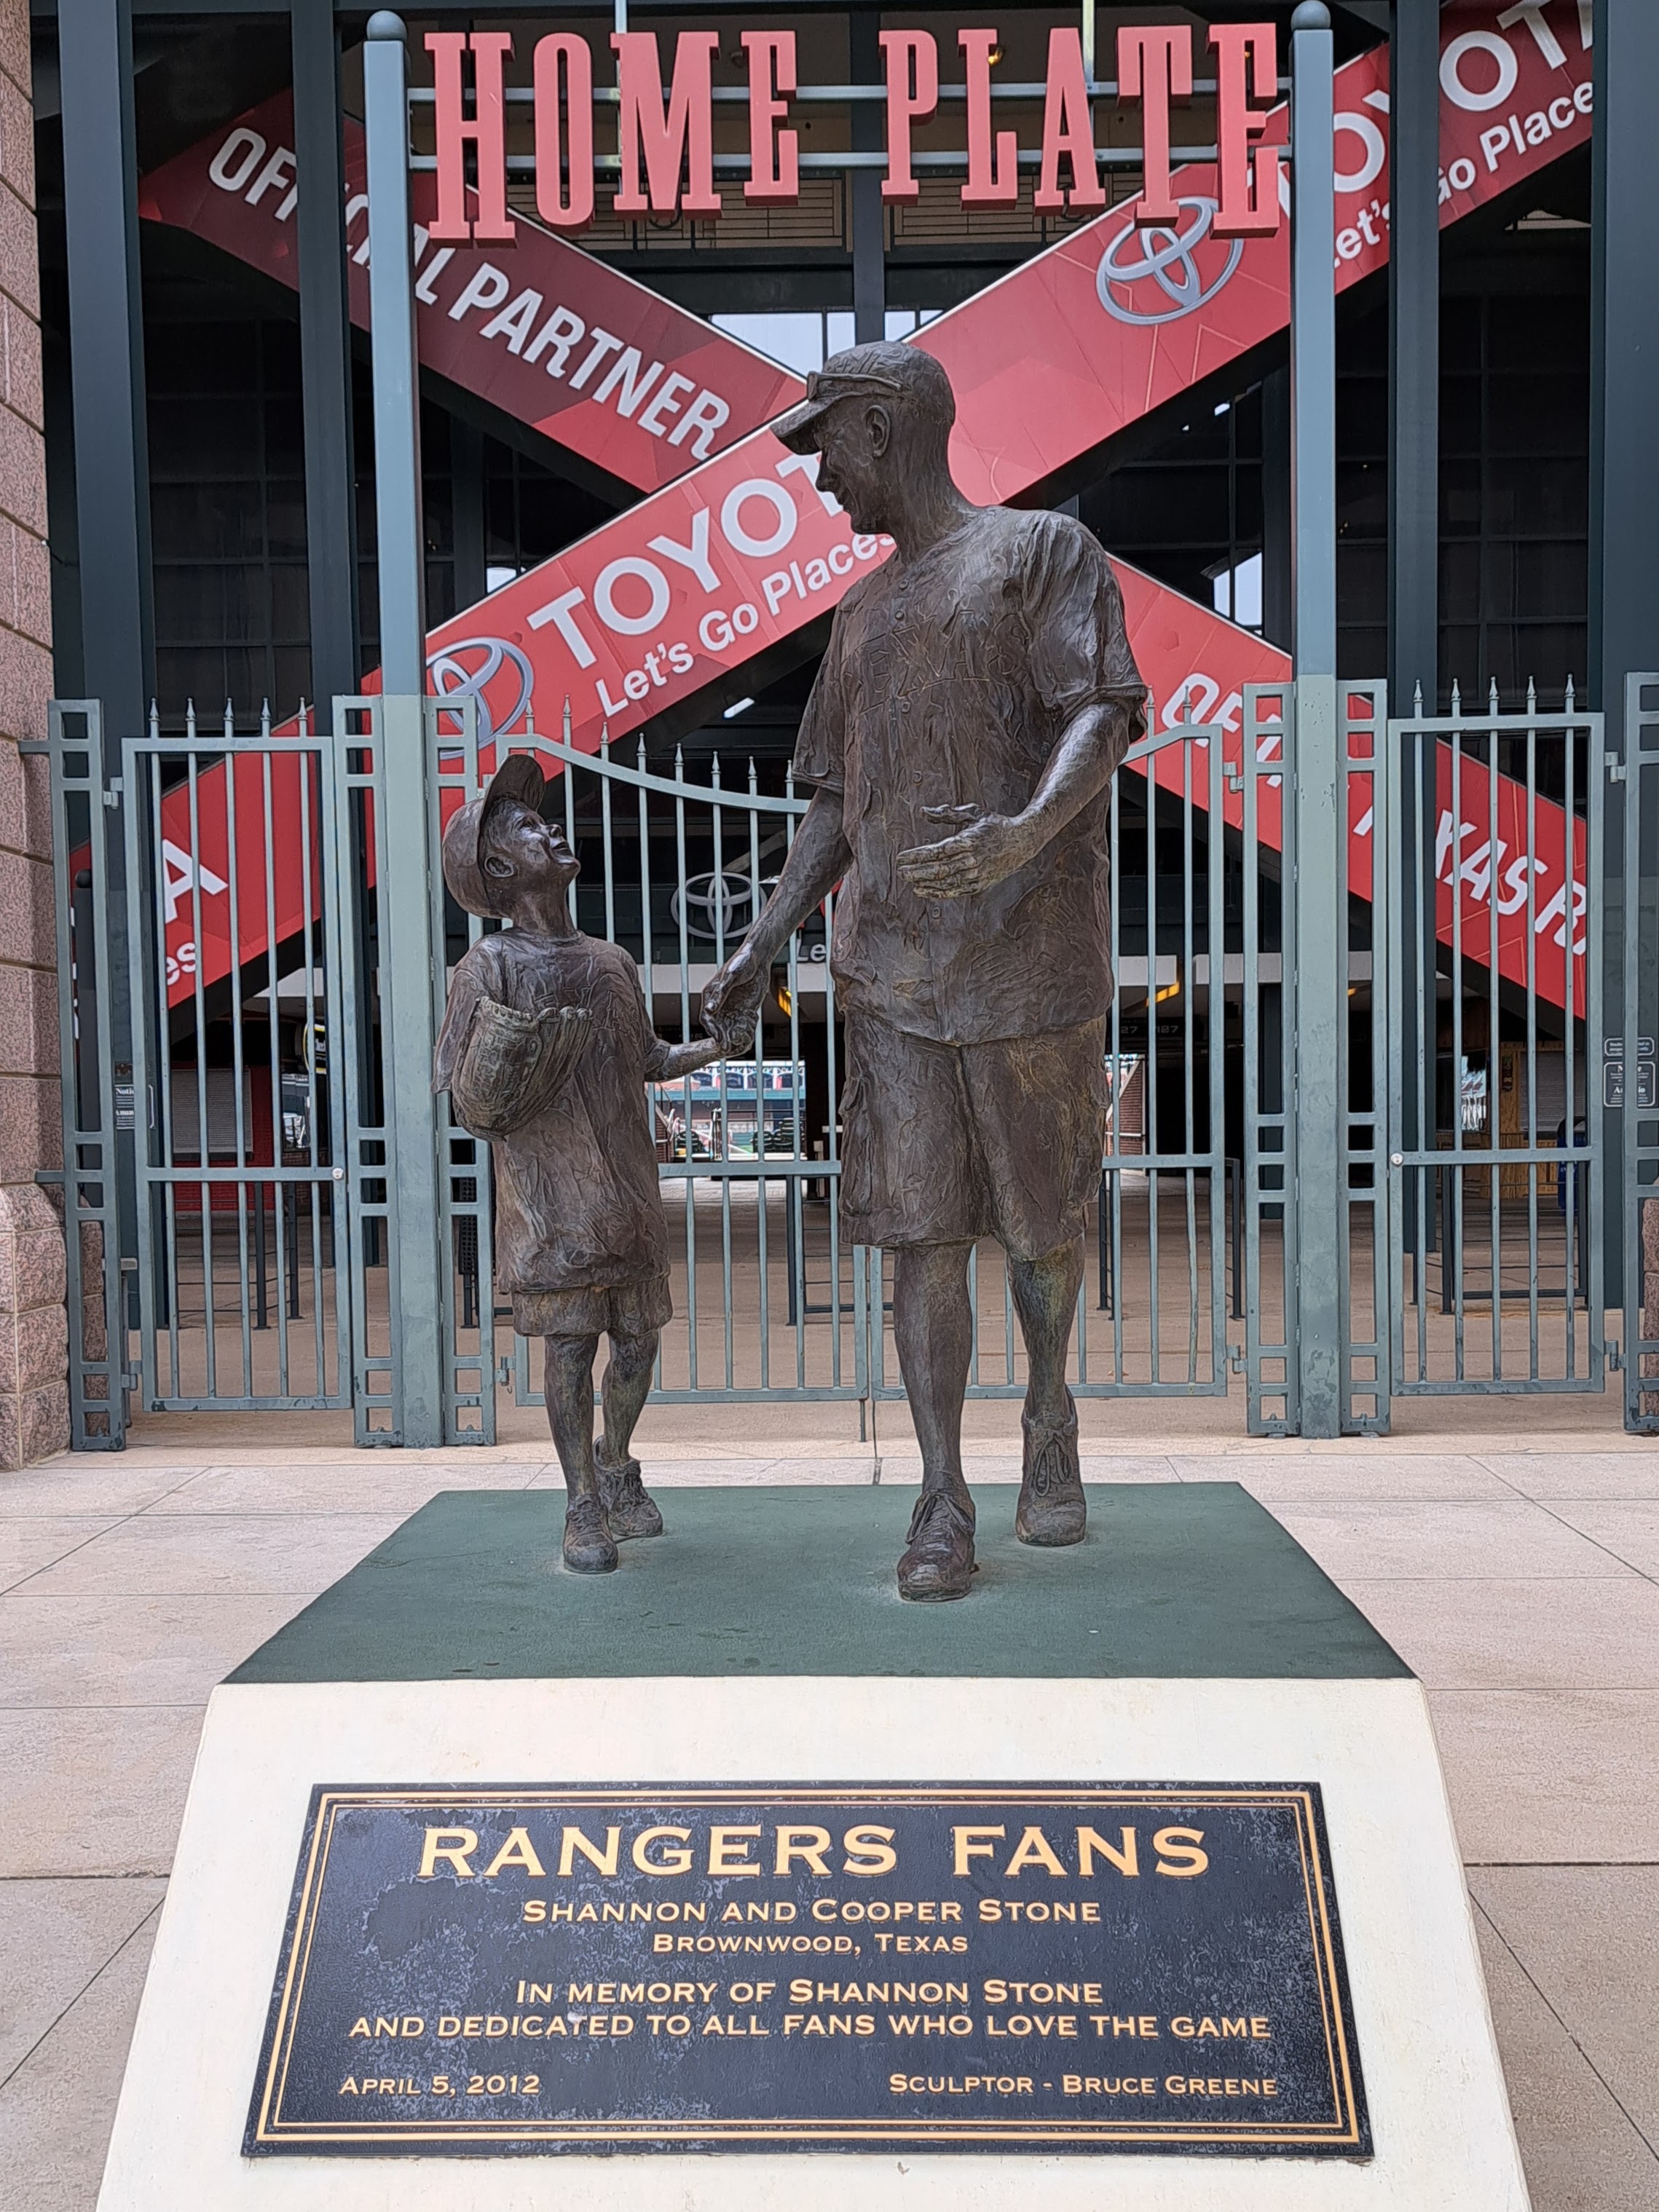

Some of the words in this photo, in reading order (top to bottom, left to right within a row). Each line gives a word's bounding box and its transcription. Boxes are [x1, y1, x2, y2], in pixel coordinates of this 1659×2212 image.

[424, 31, 800, 246] HOME
[878, 23, 1280, 239] PLATE
[446, 262, 730, 459] PARTNER
[594, 641, 694, 717] Let's
[698, 602, 758, 651] Go
[417, 1825, 897, 1877] RANGERS
[951, 1825, 1210, 1876] FANS
[430, 2074, 457, 2098] 5,
[465, 2074, 540, 2095] 2012
